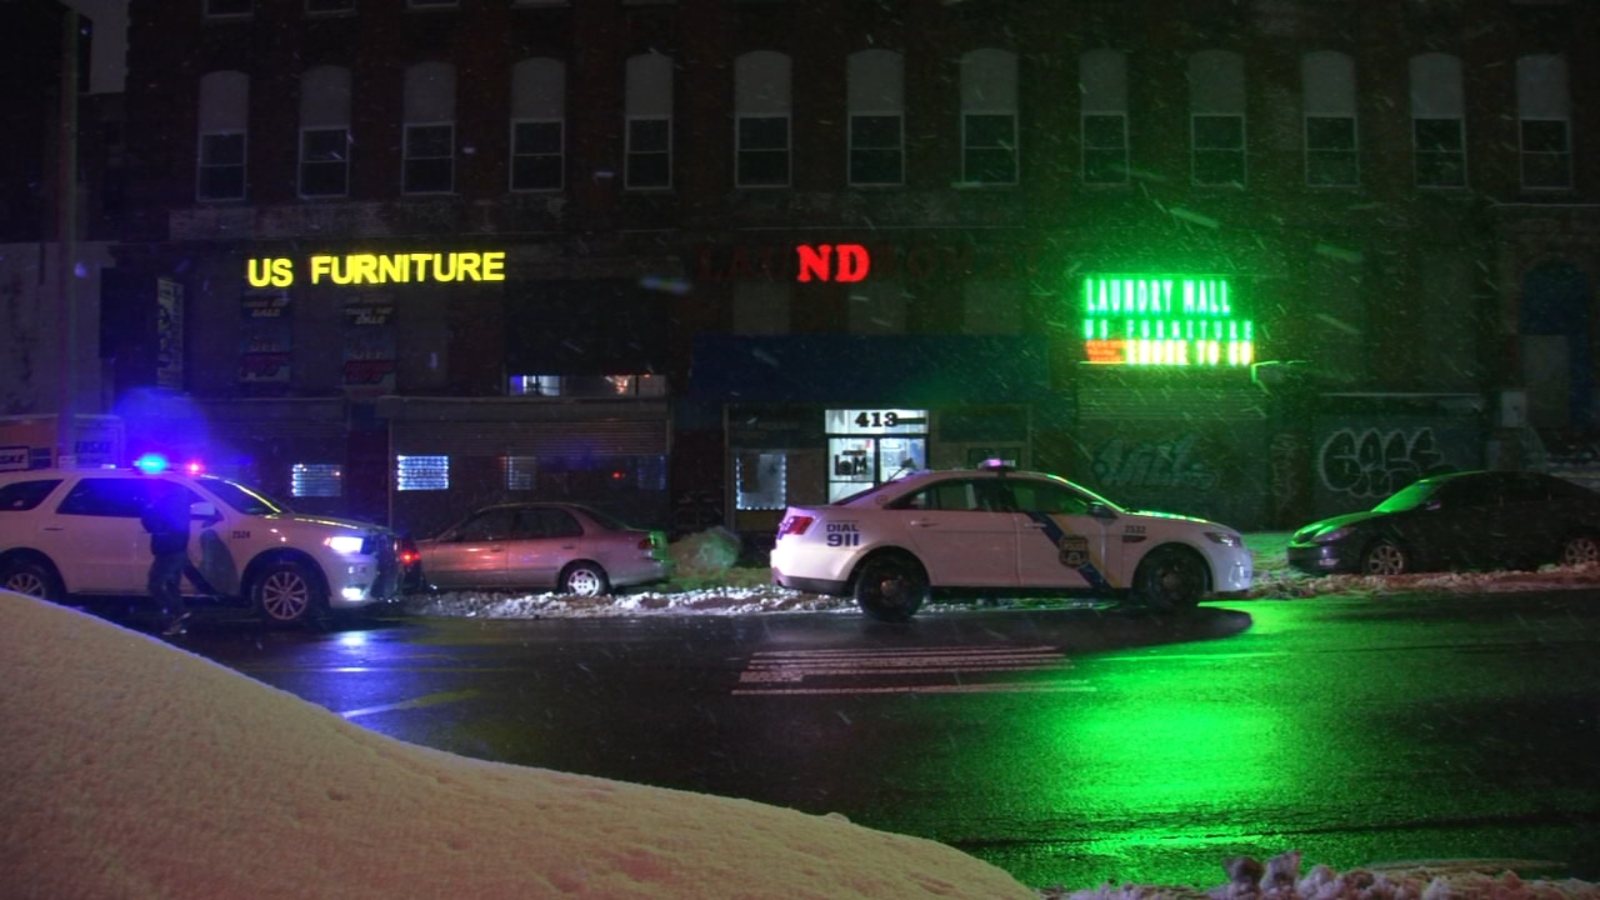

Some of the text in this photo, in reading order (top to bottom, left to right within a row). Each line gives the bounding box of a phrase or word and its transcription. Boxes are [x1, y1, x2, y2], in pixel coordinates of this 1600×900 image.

[248, 252, 505, 287] US FURNITURE
[1085, 279, 1231, 315] LAUNDRY MALL
[1084, 319, 1252, 341] US FURNITURE
[855, 411, 899, 428] 413
[75, 441, 112, 453] ENSKE
[826, 523, 859, 532] DIAL
[826, 533, 859, 547] 911
